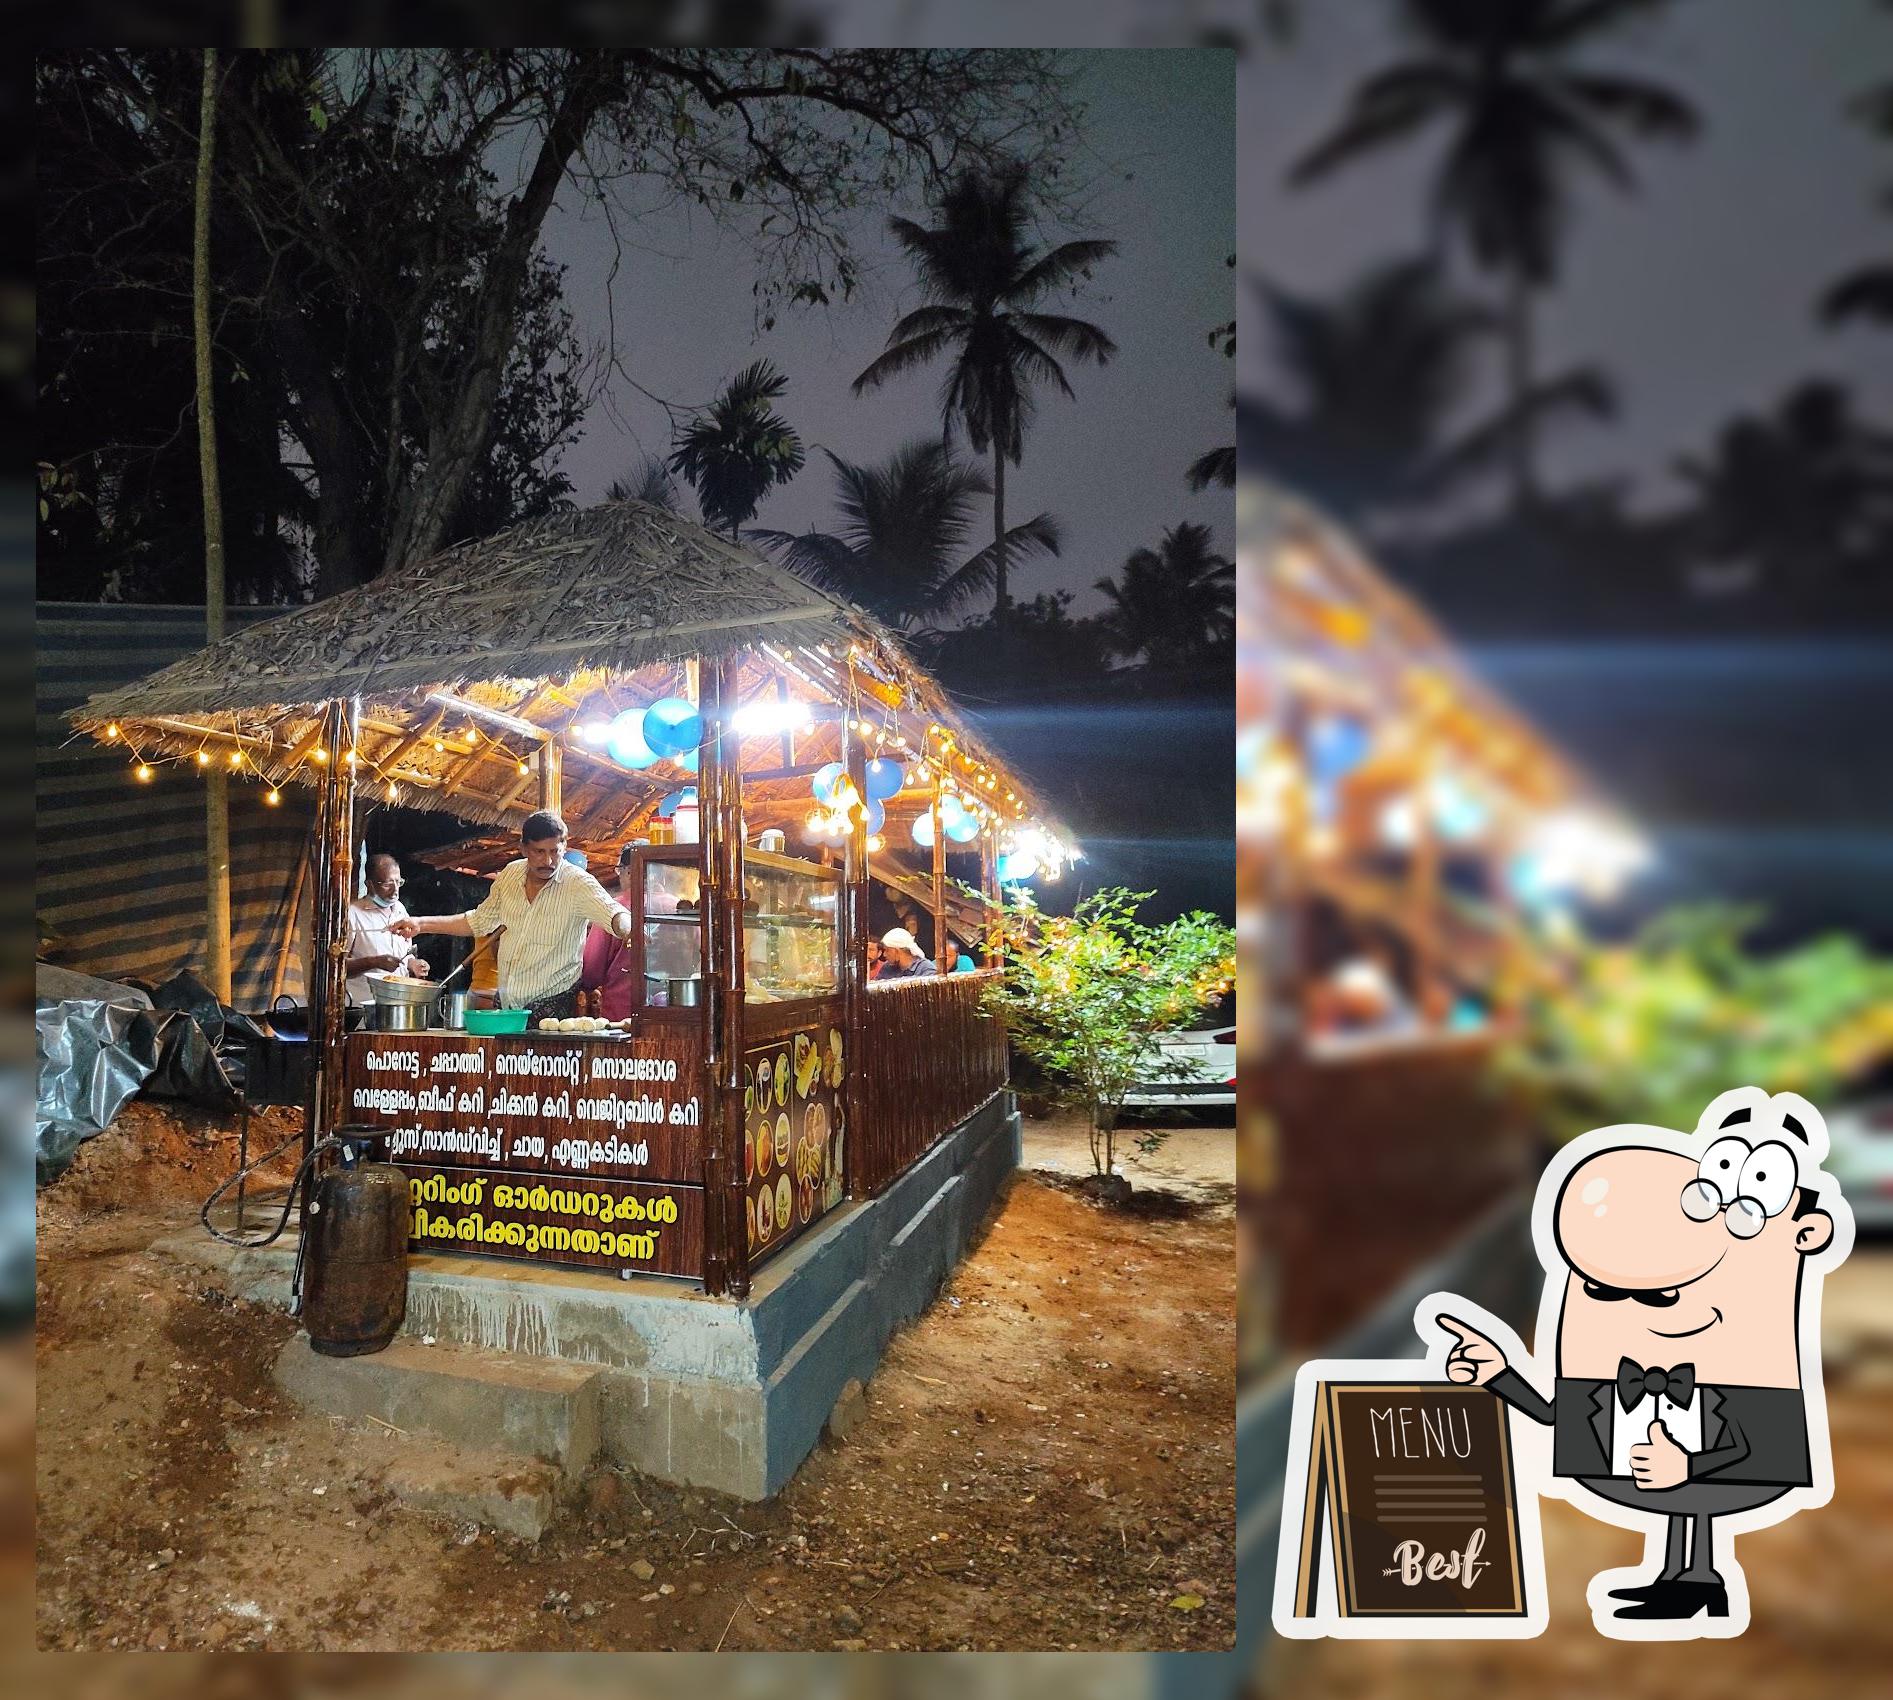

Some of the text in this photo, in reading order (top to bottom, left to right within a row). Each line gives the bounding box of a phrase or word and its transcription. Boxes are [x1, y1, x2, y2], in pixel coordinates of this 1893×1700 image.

[457, 1086, 484, 1114] കറി
[668, 1096, 699, 1126] കറി
[493, 1184, 678, 1224] ഓർഡറുകൾ
